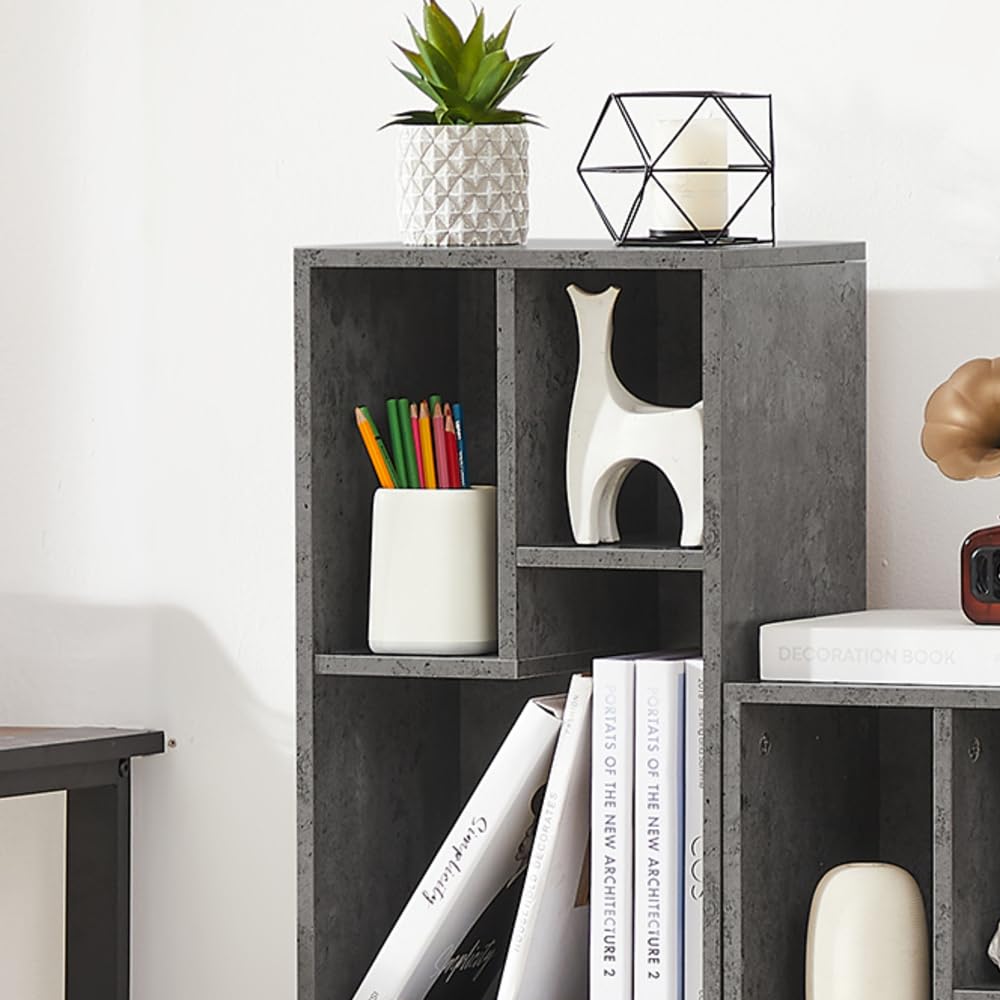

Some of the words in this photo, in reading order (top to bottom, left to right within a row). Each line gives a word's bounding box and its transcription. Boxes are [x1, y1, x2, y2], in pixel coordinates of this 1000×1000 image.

[777, 645, 898, 664] DECORATION
[902, 649, 956, 665] BOOK
[604, 755, 617, 777] OF
[647, 757, 660, 779] OF
[604, 781, 617, 808] THE
[647, 784, 660, 809] THE
[604, 813, 616, 849] NEW
[647, 815, 660, 851] NEW
[604, 854, 616, 961] ARCHITECTURE
[647, 856, 660, 964] ARCHITECTURE
[604, 967, 615, 977] 2
[648, 970, 660, 979] 2
